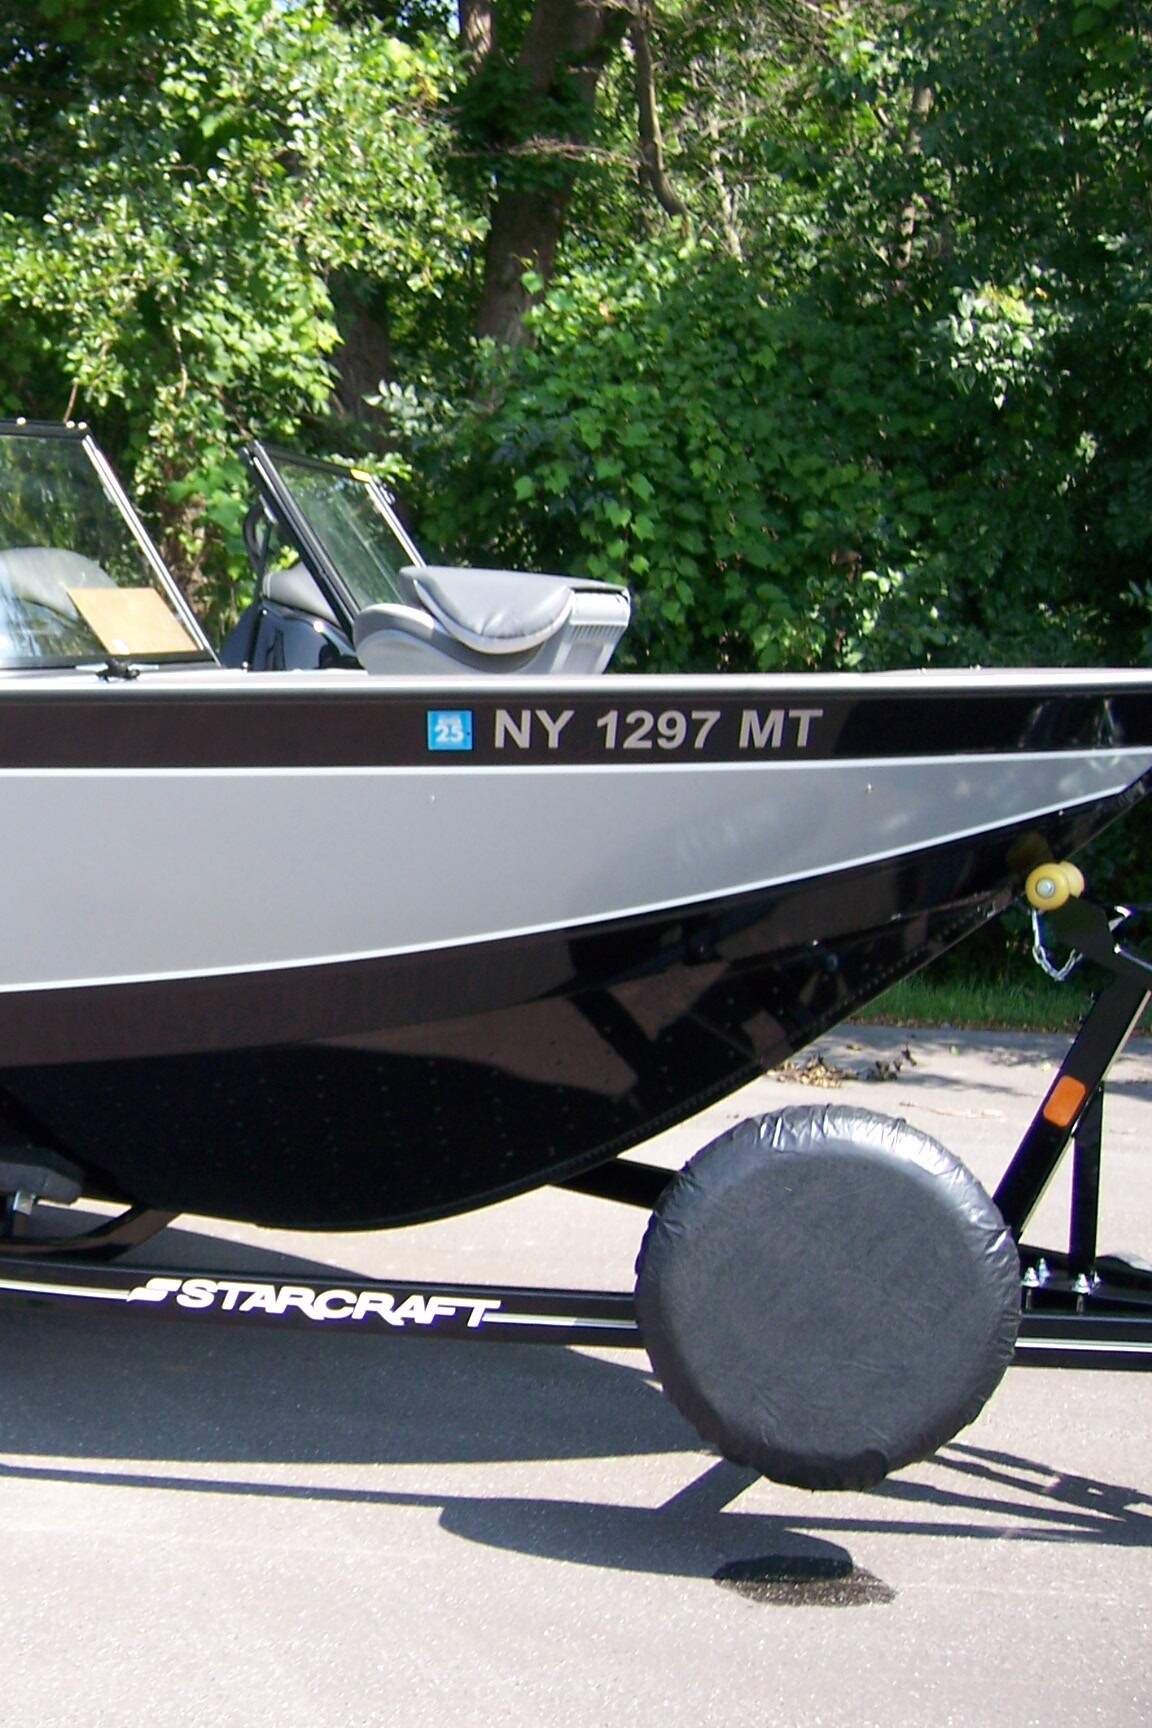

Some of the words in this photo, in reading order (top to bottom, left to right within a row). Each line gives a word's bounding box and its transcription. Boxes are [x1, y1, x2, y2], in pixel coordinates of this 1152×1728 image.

[494, 709, 575, 749] NY
[596, 709, 722, 749] 1297
[739, 708, 824, 748] MT
[176, 1278, 502, 1328] STARCRAFT
